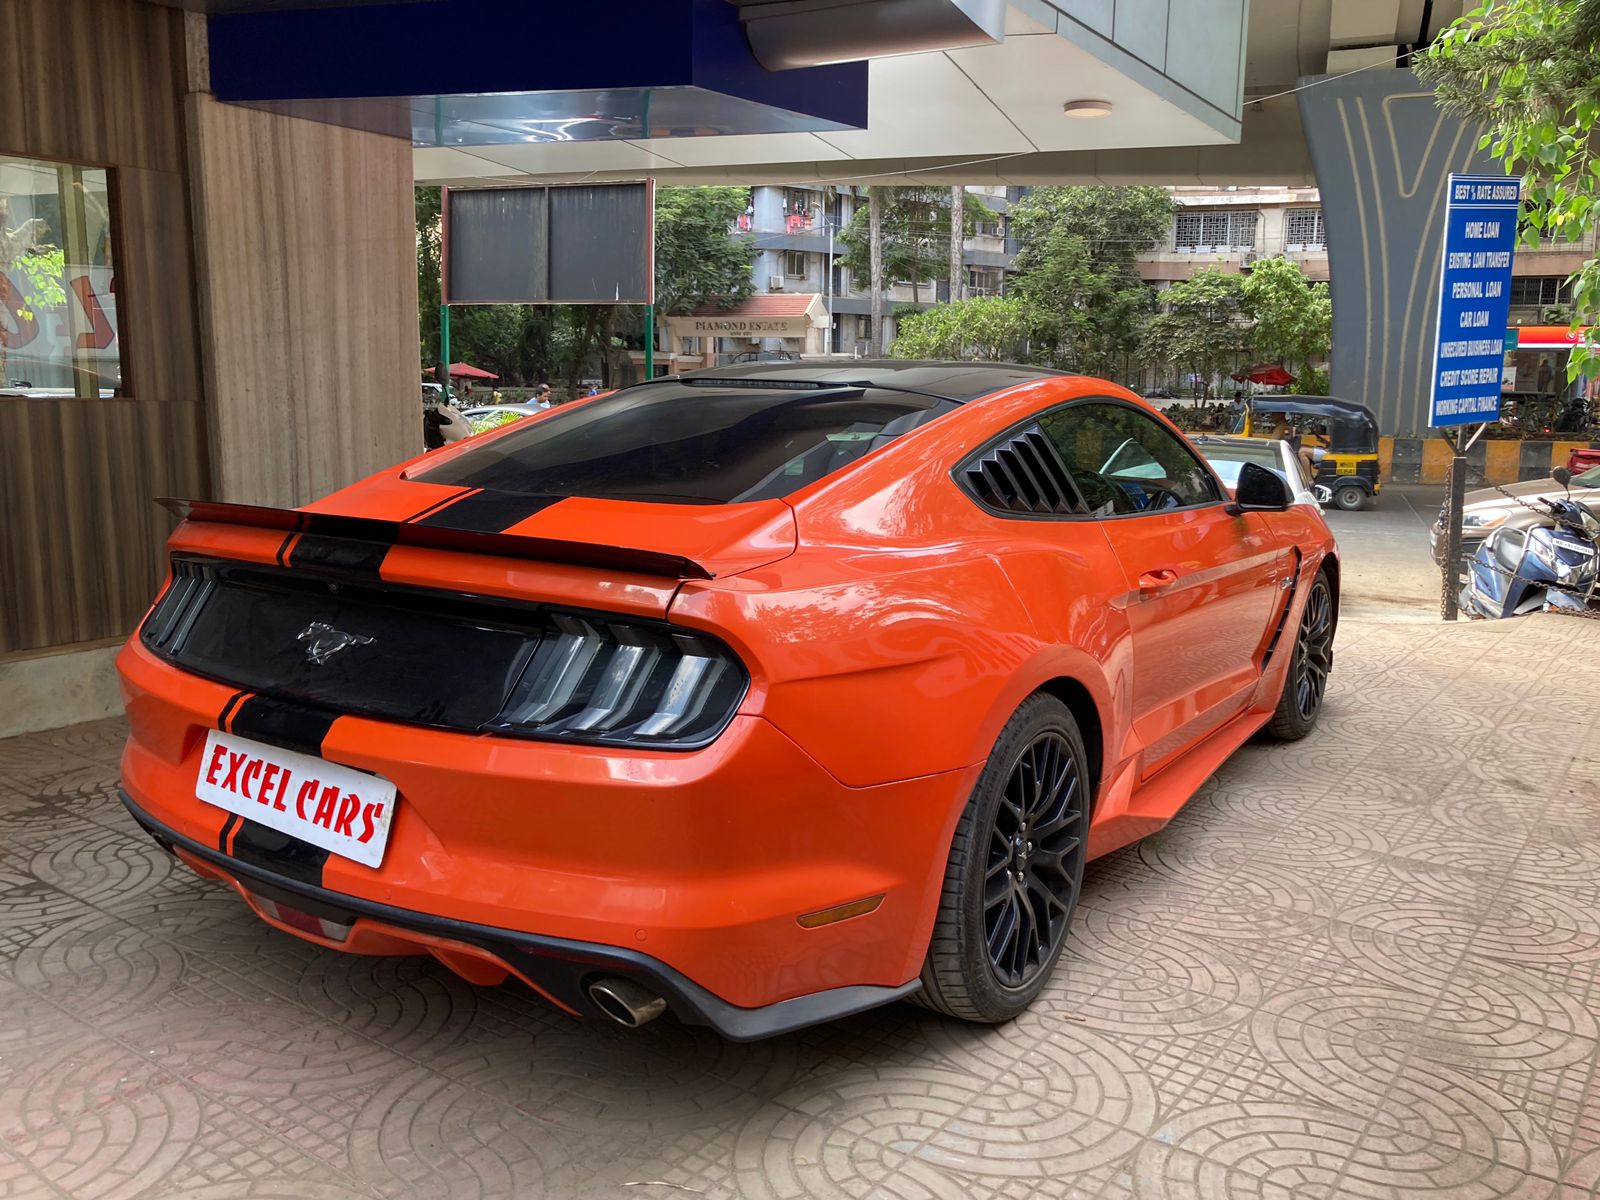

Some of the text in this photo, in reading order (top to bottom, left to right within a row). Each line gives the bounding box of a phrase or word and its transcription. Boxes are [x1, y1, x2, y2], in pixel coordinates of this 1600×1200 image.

[1455, 185, 1517, 200] BEST % RATE ASSURED
[1465, 222, 1500, 238] HOME LOAN
[1449, 252, 1510, 268] EXISTING LOAN TRANSFER
[1452, 281, 1502, 298] PERSONAL LOAN
[749, 321, 788, 331] ESTATE
[1460, 311, 1490, 328] CAR LOAN
[1440, 341, 1468, 358] UNSECURED
[1490, 339, 1503, 355] LOAN
[1440, 367, 1498, 387] CREDIT SCORE REPAIR
[1436, 395, 1498, 416] WORKING CAPITAL FINANCE
[206, 744, 384, 844] EXCEL CARS
